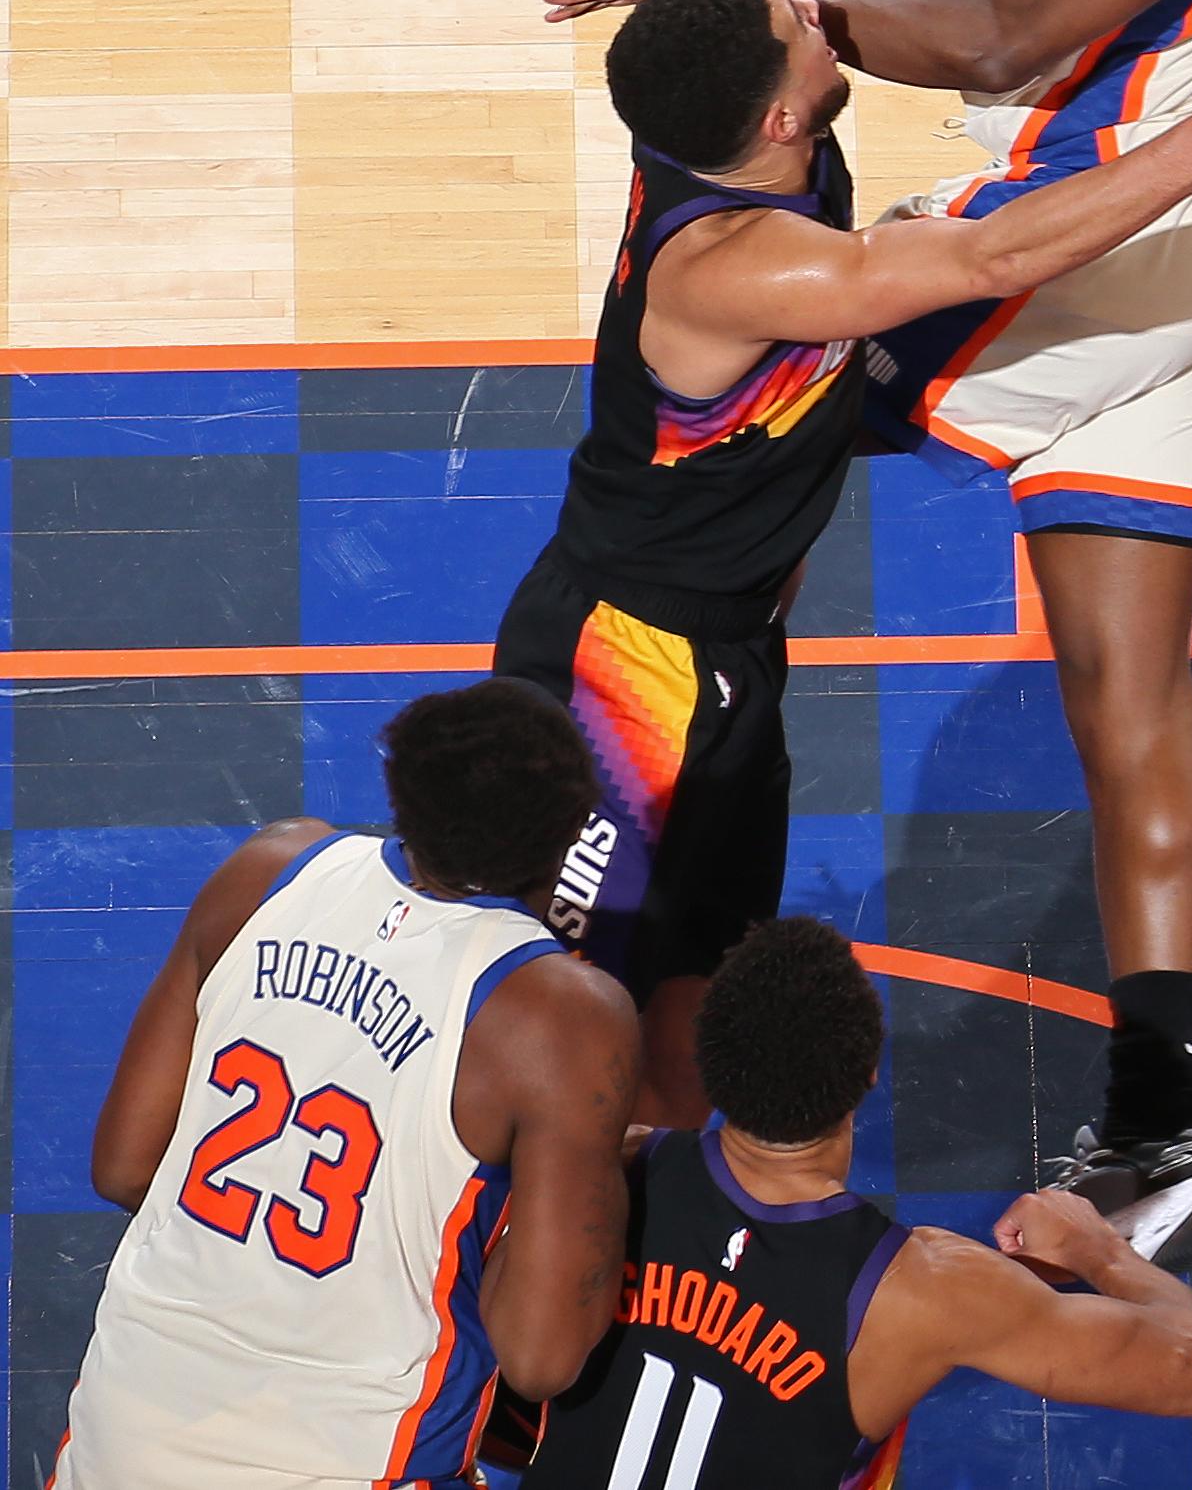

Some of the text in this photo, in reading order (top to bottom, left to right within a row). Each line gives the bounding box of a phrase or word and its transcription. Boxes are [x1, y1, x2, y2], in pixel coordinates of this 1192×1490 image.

[254, 939, 435, 1075] ROBINSON
[176, 1037, 383, 1279] 23
[614, 1261, 827, 1402] GHODARO
[606, 1351, 724, 1490] 11
